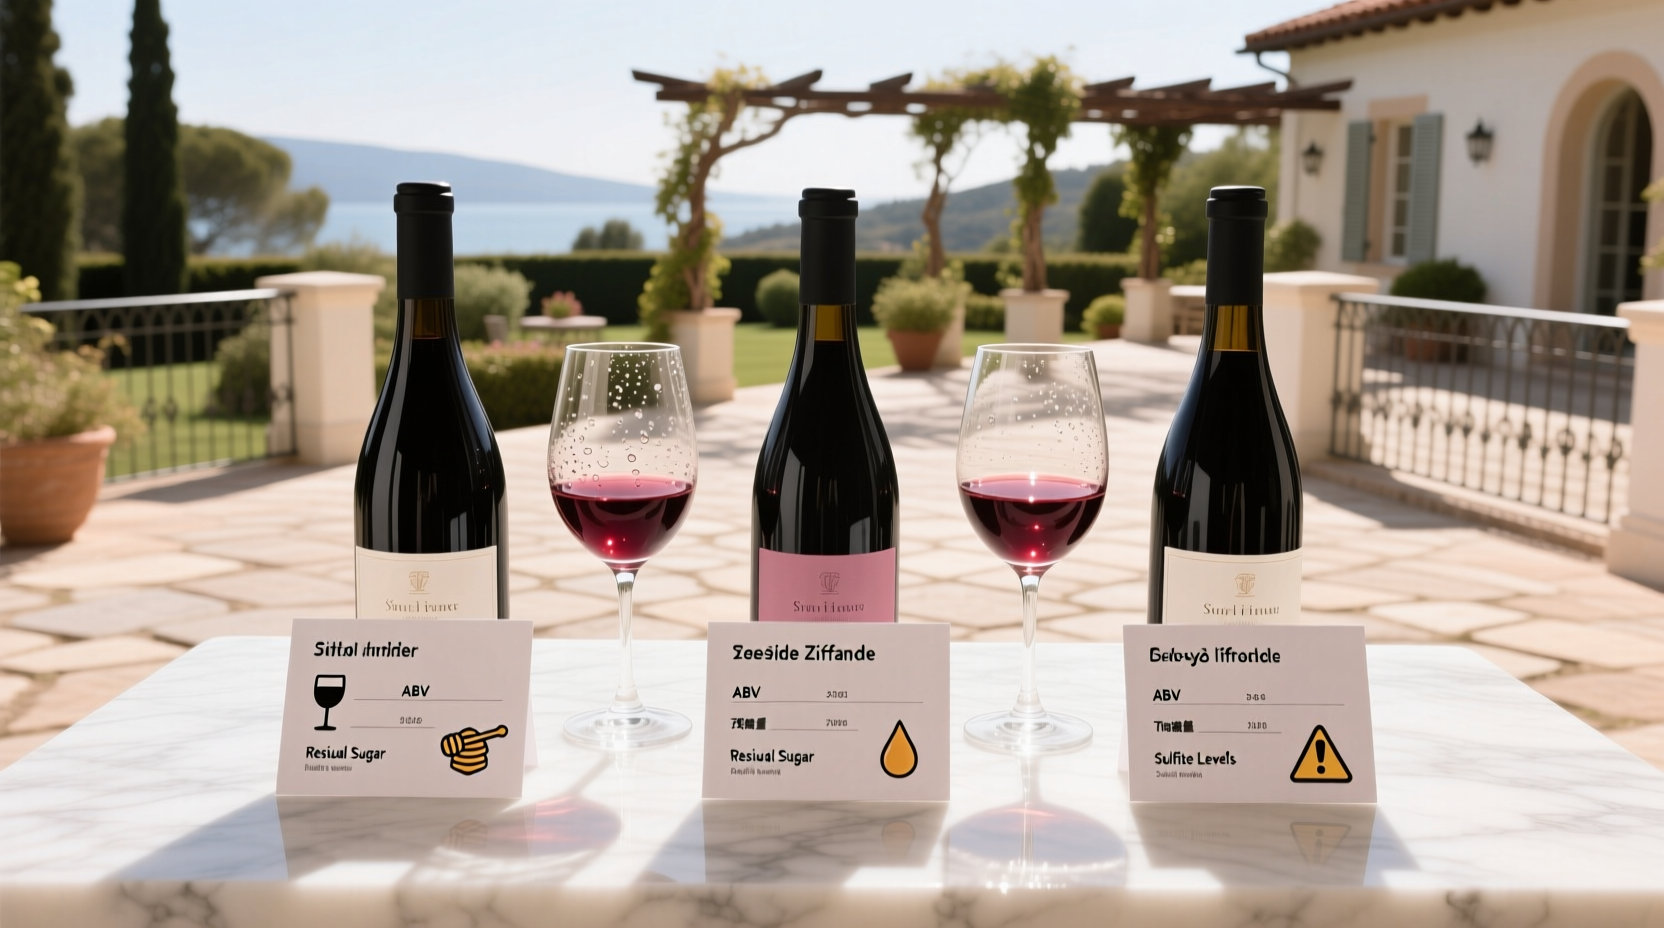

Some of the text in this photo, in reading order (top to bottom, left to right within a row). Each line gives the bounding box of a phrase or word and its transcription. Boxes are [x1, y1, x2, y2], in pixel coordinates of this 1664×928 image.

[401, 684, 430, 697] ABV
[732, 686, 761, 698] ABV
[1152, 689, 1181, 701] ABV
[350, 746, 386, 763] Sugar
[778, 749, 815, 766] Sugar
[1154, 750, 1237, 765] Sulfite Levels
